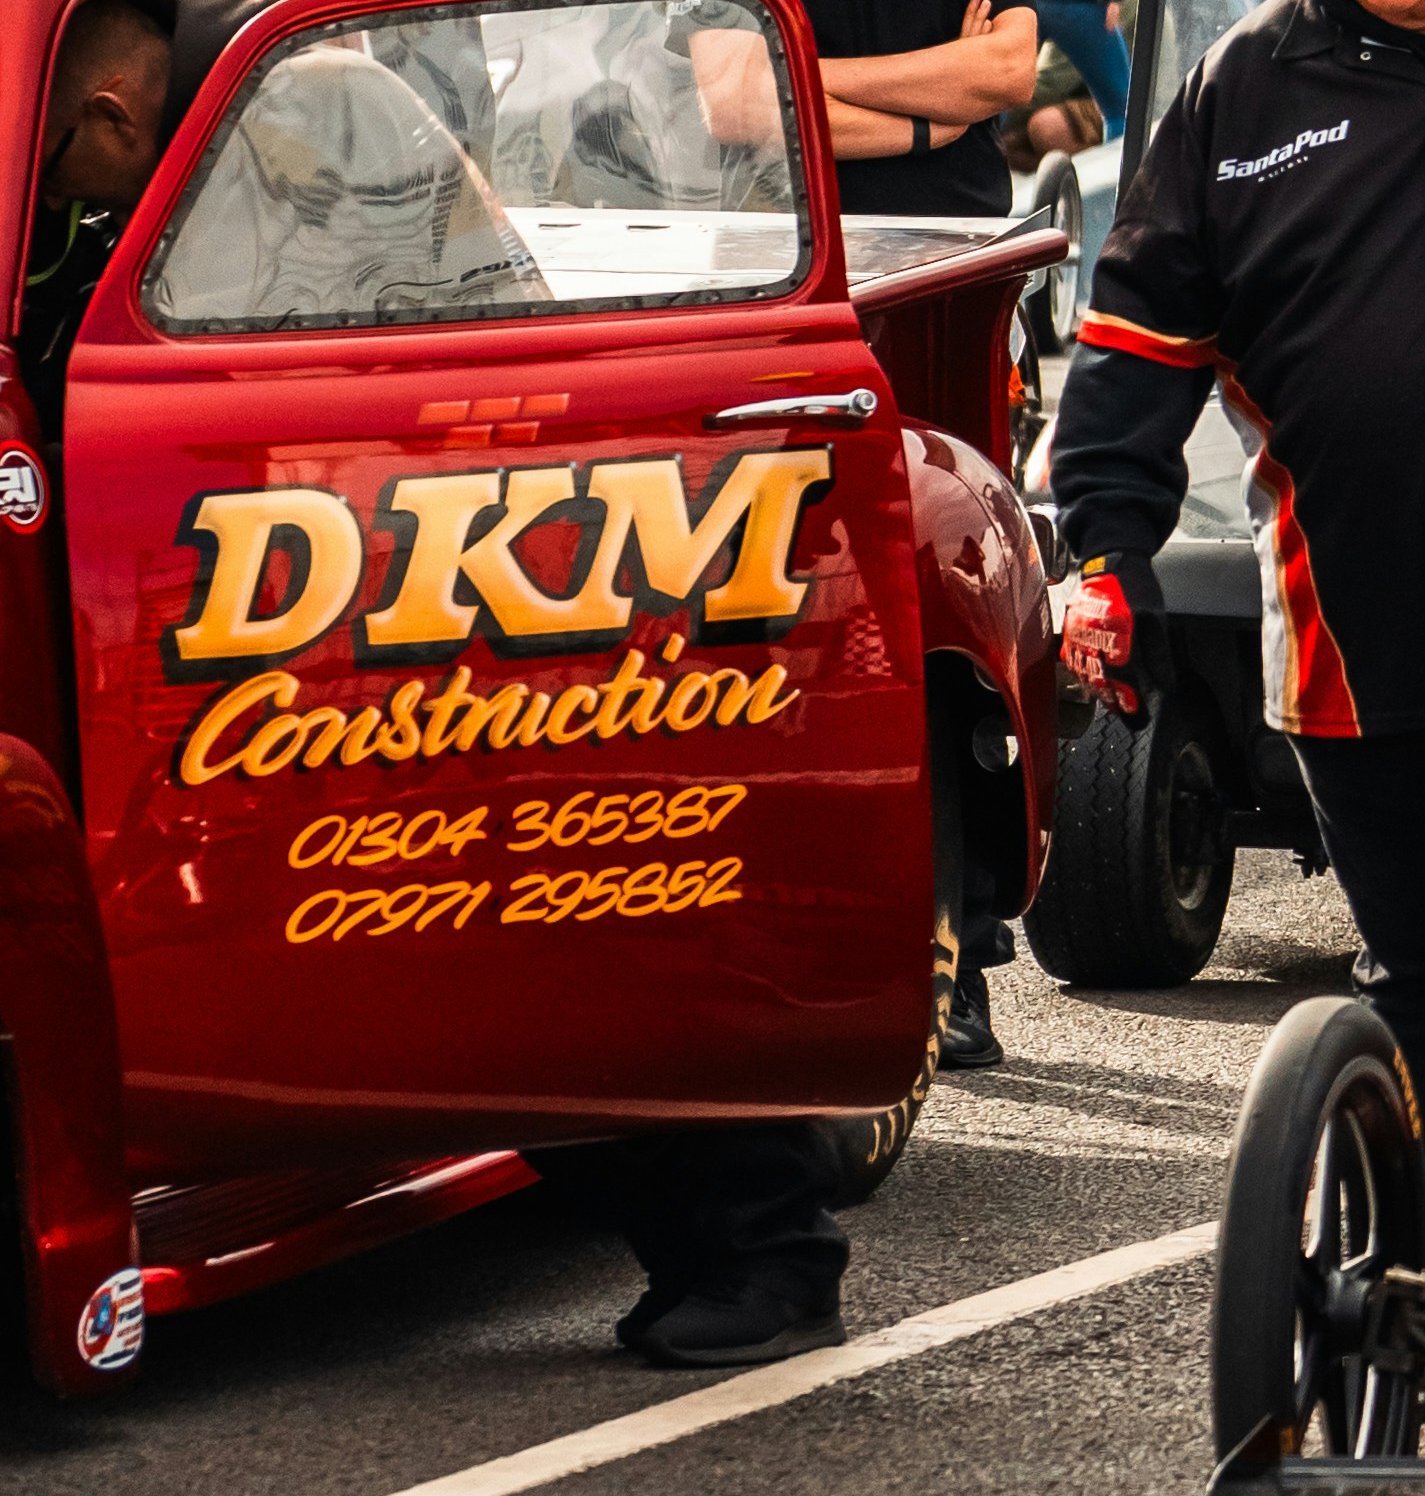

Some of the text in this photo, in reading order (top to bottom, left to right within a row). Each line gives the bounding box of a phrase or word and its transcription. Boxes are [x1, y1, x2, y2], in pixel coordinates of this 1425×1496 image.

[172, 447, 833, 664] DKM
[176, 632, 802, 787] Construction
[286, 783, 748, 870] 01304 365387
[284, 856, 745, 945] 07971 295852
